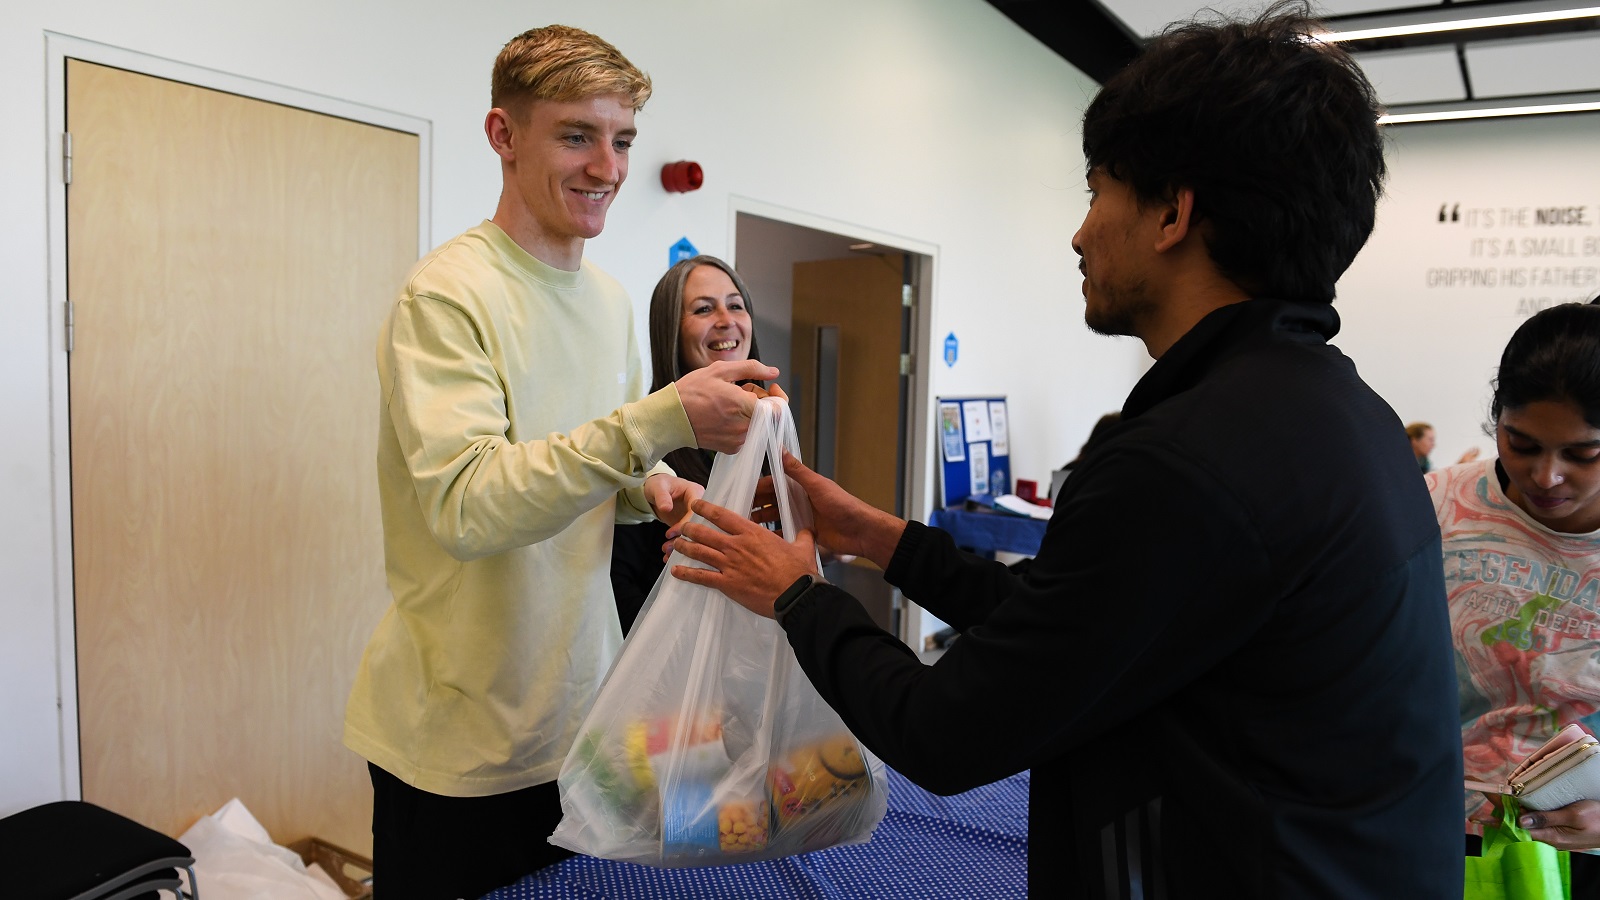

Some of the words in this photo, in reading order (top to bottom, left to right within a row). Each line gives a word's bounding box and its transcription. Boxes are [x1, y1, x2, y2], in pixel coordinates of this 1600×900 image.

[1499, 207, 1529, 228] THE
[1470, 237, 1501, 257] IT'S
[1503, 238, 1517, 257] A
[1520, 237, 1577, 257] SMALL
[1426, 267, 1497, 288] GRIPPING
[1501, 267, 1528, 288] HIS
[1531, 266, 1600, 288] FATHER
[1465, 591, 1521, 621] ATHL
[1535, 608, 1597, 639] DEPT
[1492, 624, 1547, 653] 1990
